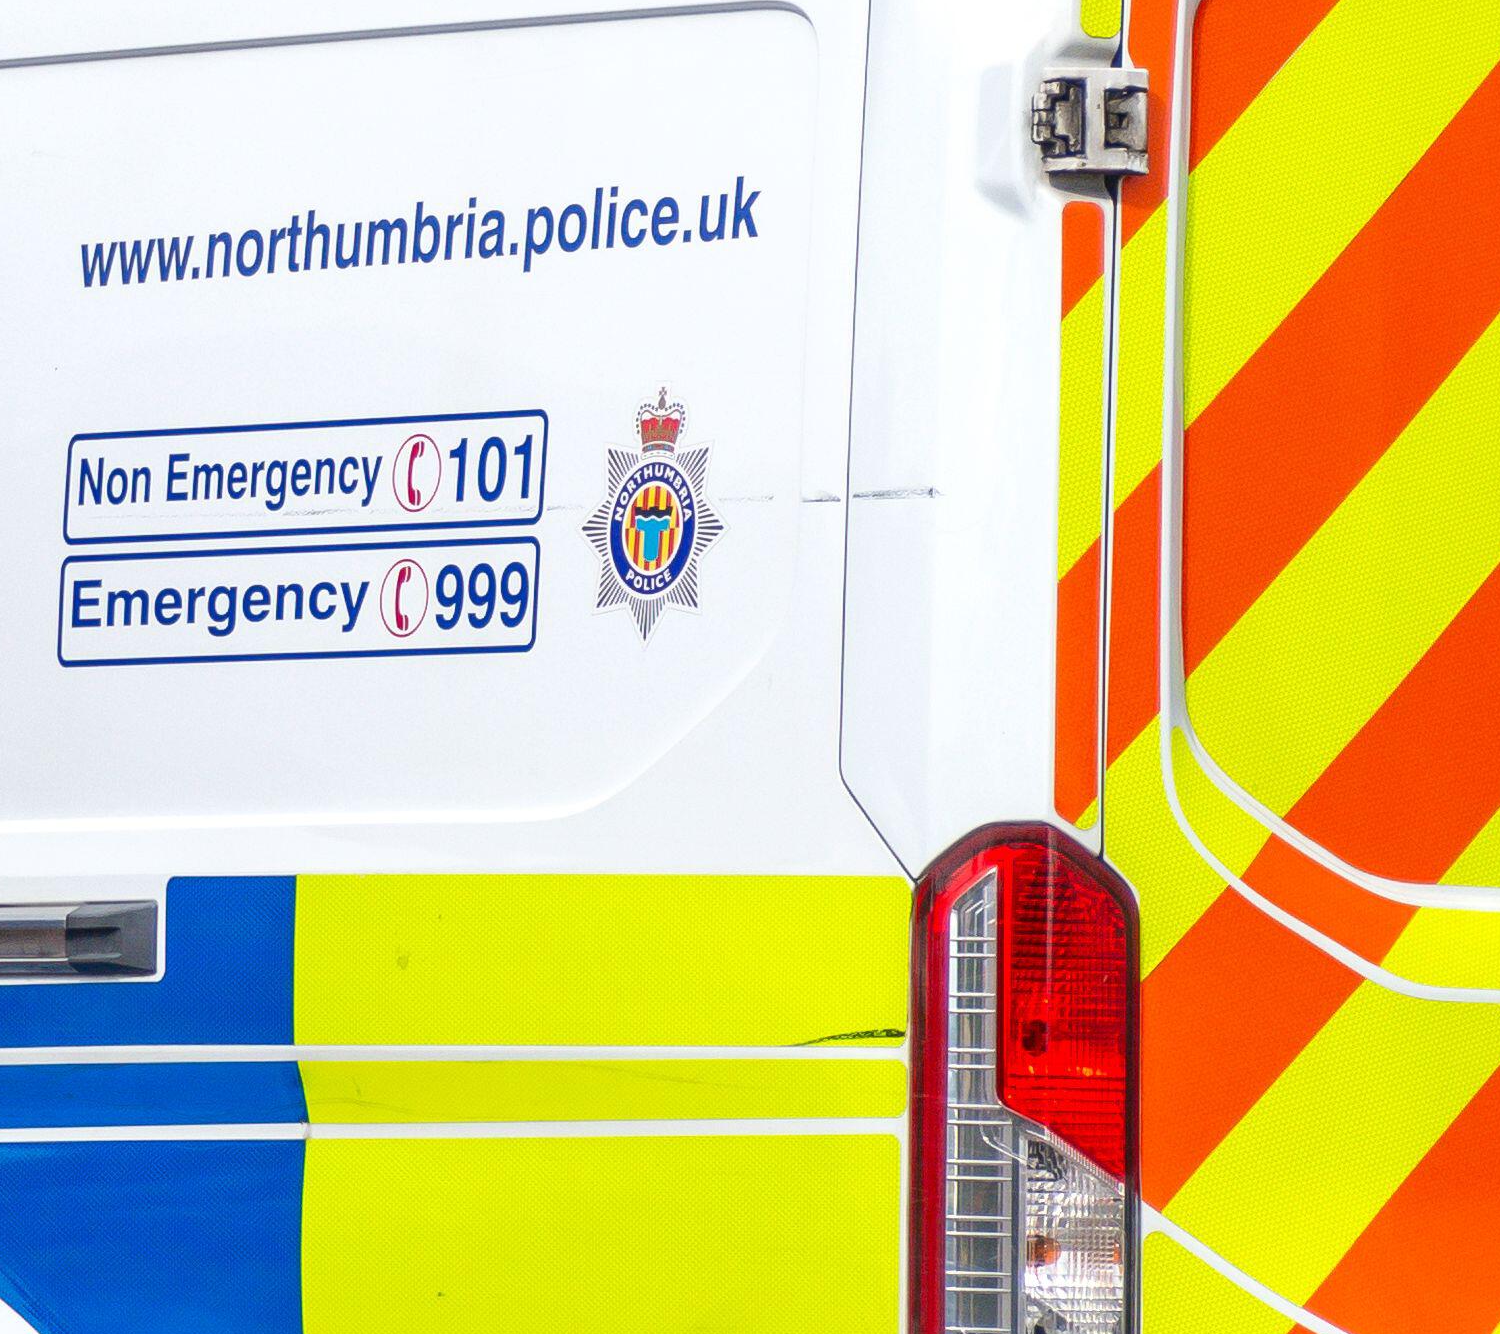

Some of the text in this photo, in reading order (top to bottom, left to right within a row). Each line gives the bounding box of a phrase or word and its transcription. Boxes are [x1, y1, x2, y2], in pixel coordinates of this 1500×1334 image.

[80, 175, 762, 289] www.northumbria.police.uk
[77, 434, 536, 512] Non Emergency 101
[614, 464, 692, 522] NORTHUMBRIA
[70, 561, 530, 637] Emergency 999
[625, 568, 672, 591] POLICE
